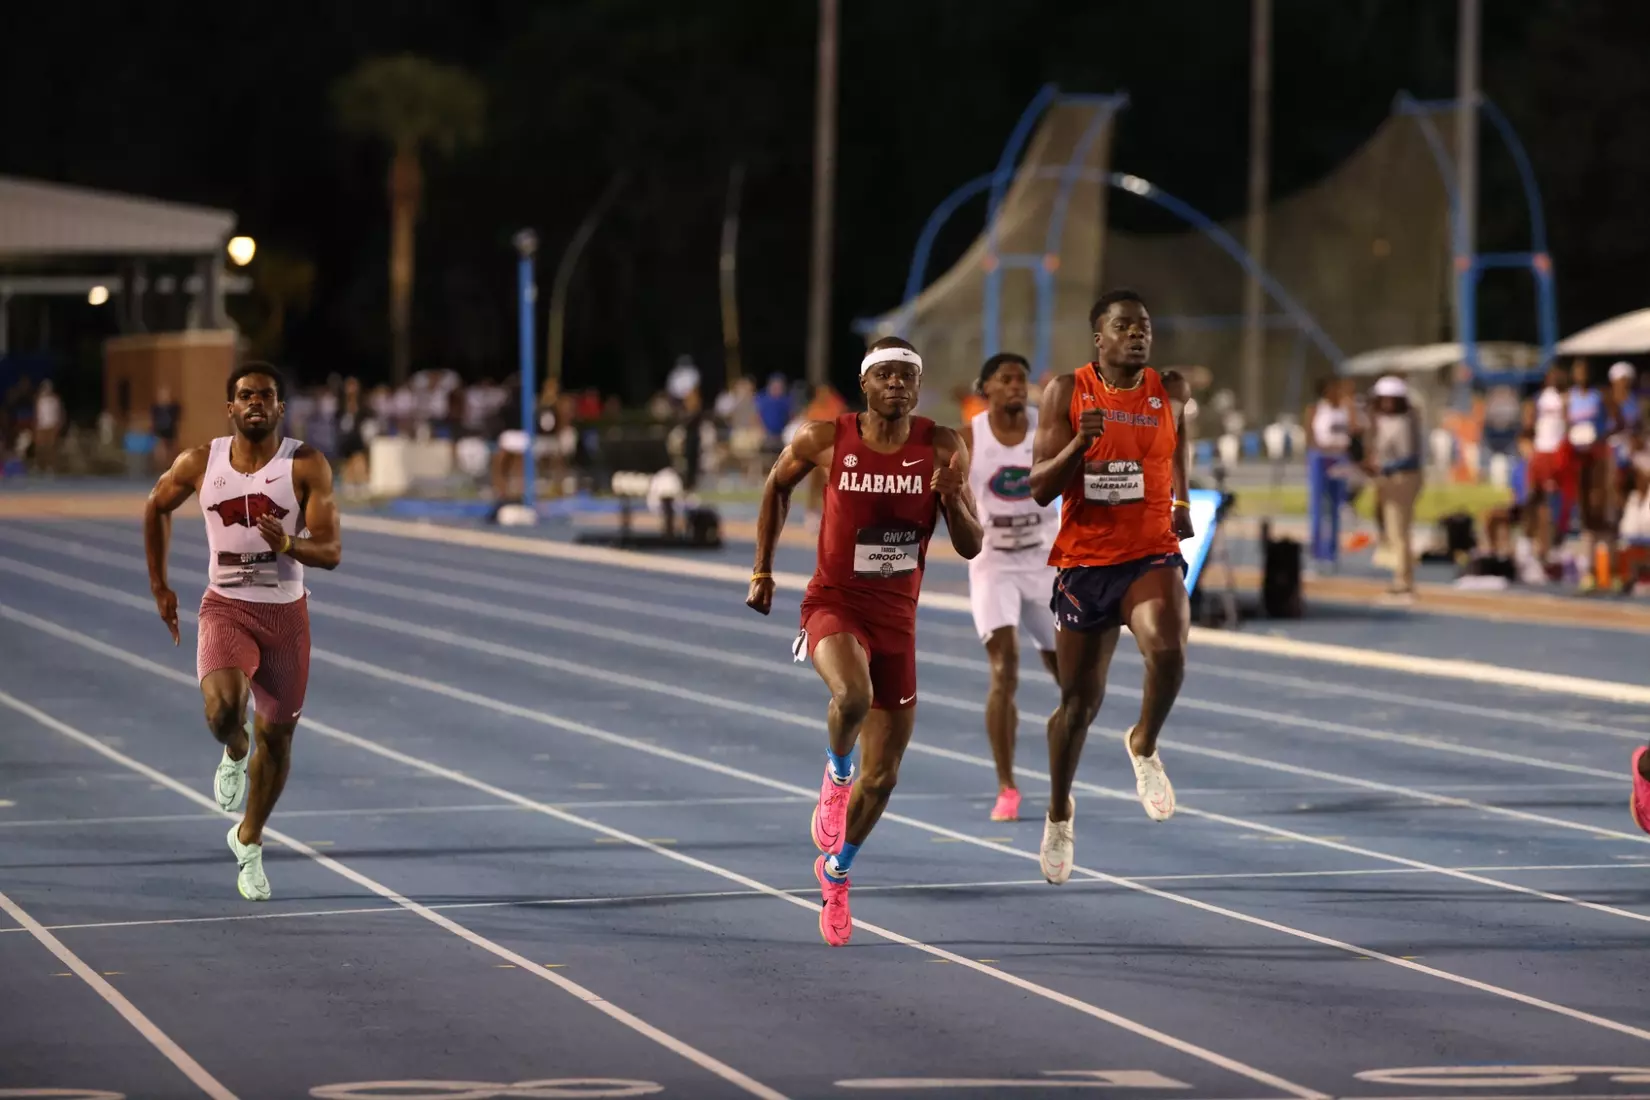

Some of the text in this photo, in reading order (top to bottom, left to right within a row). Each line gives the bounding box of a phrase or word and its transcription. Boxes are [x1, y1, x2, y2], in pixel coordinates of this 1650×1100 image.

[1103, 409, 1159, 427] UBURN
[1108, 462, 1125, 473] GNV
[838, 471, 923, 494] ALABAMA
[1090, 481, 1139, 490] CHARAMBA
[883, 531, 904, 543] GNV
[868, 552, 908, 561] OROGOT
